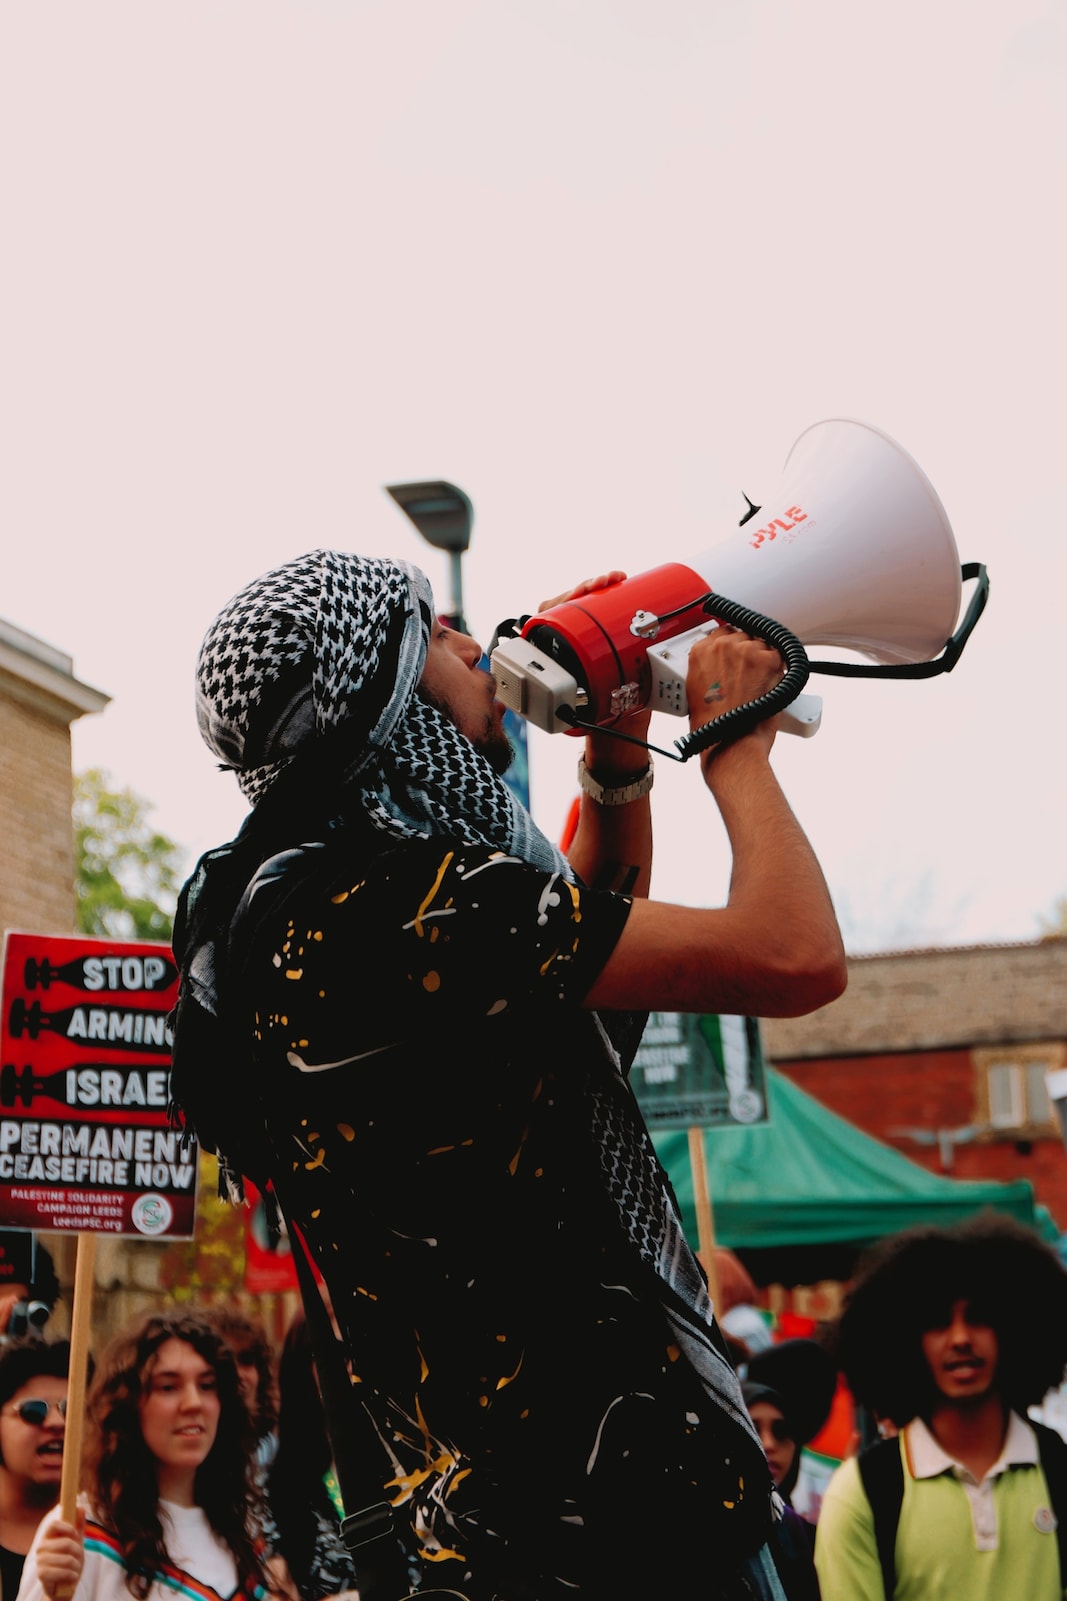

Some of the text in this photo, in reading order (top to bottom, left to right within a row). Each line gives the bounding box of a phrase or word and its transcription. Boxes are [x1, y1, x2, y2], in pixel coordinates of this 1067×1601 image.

[82, 956, 167, 991] STOP
[0, 1153, 194, 1190] CEASEFIRE NOW
[10, 1188, 125, 1206] PALESTINE SOLIDARITY
[37, 1202, 123, 1217] CAMPAIGN LEEDS
[52, 1216, 123, 1232] LeedsPSC.org
